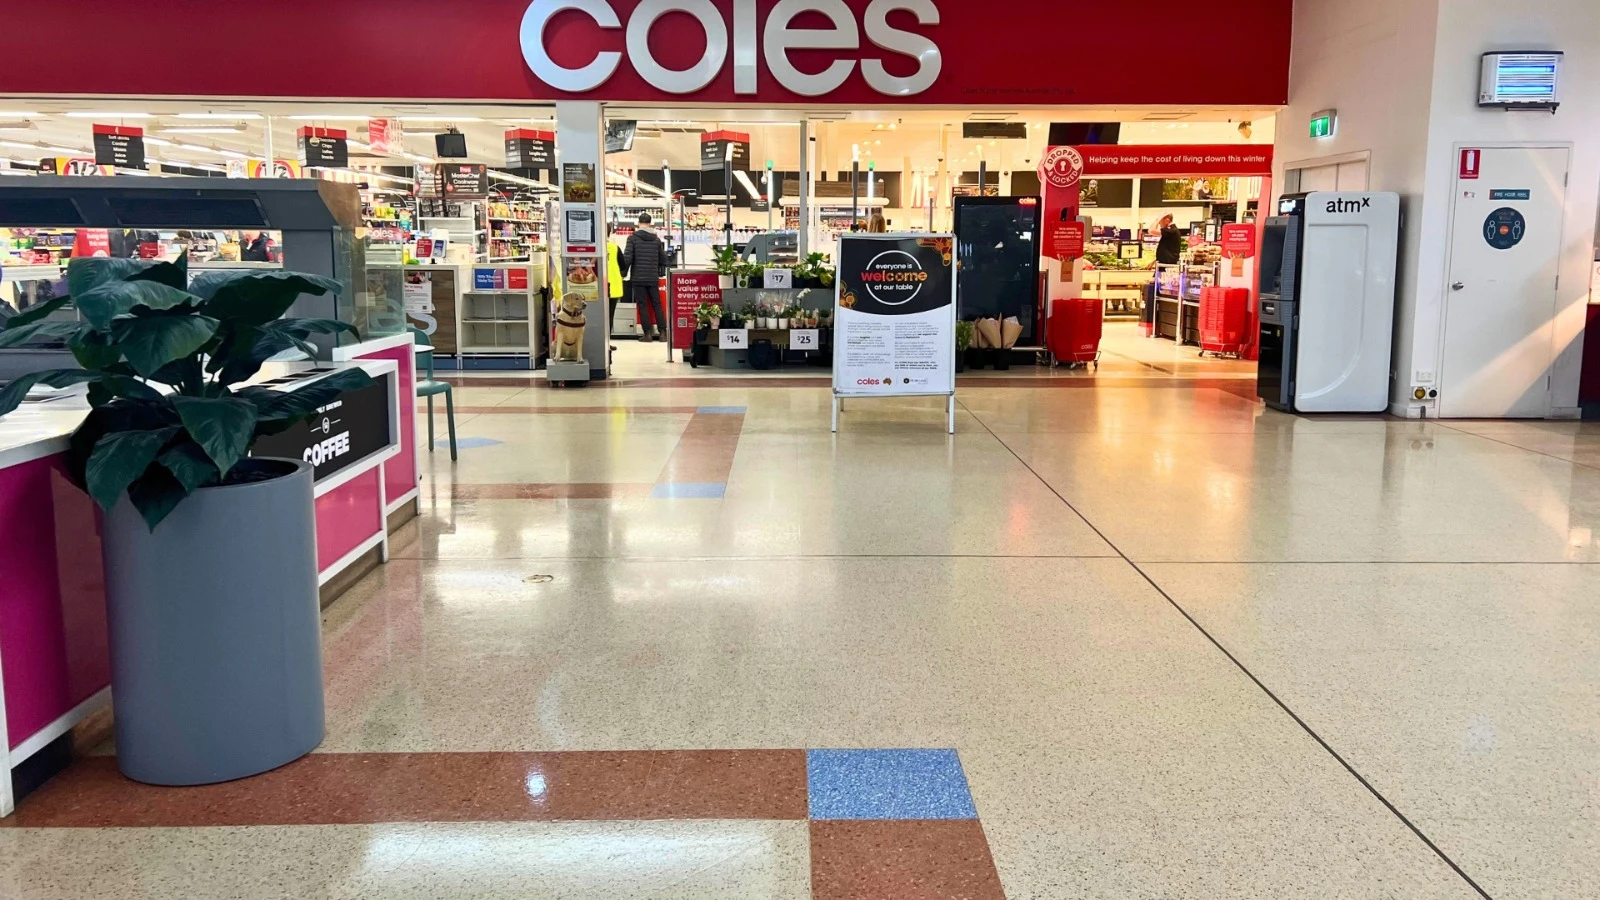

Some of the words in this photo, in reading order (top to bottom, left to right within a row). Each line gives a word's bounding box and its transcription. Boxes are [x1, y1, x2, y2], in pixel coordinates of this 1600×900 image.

[519, 0, 942, 96] coles
[1047, 149, 1080, 165] DROPPED
[1089, 156, 1118, 164] Helping
[1155, 155, 1172, 163] cost
[1182, 154, 1203, 164] living
[1228, 154, 1241, 162] this
[1242, 154, 1266, 162] winter
[1052, 170, 1078, 184] LOCKED
[772, 275, 784, 283] $17
[861, 270, 928, 281] welcome
[727, 335, 740, 343] $14
[797, 335, 811, 343] $25
[856, 377, 880, 385] coles
[303, 431, 350, 467] COFFEE
